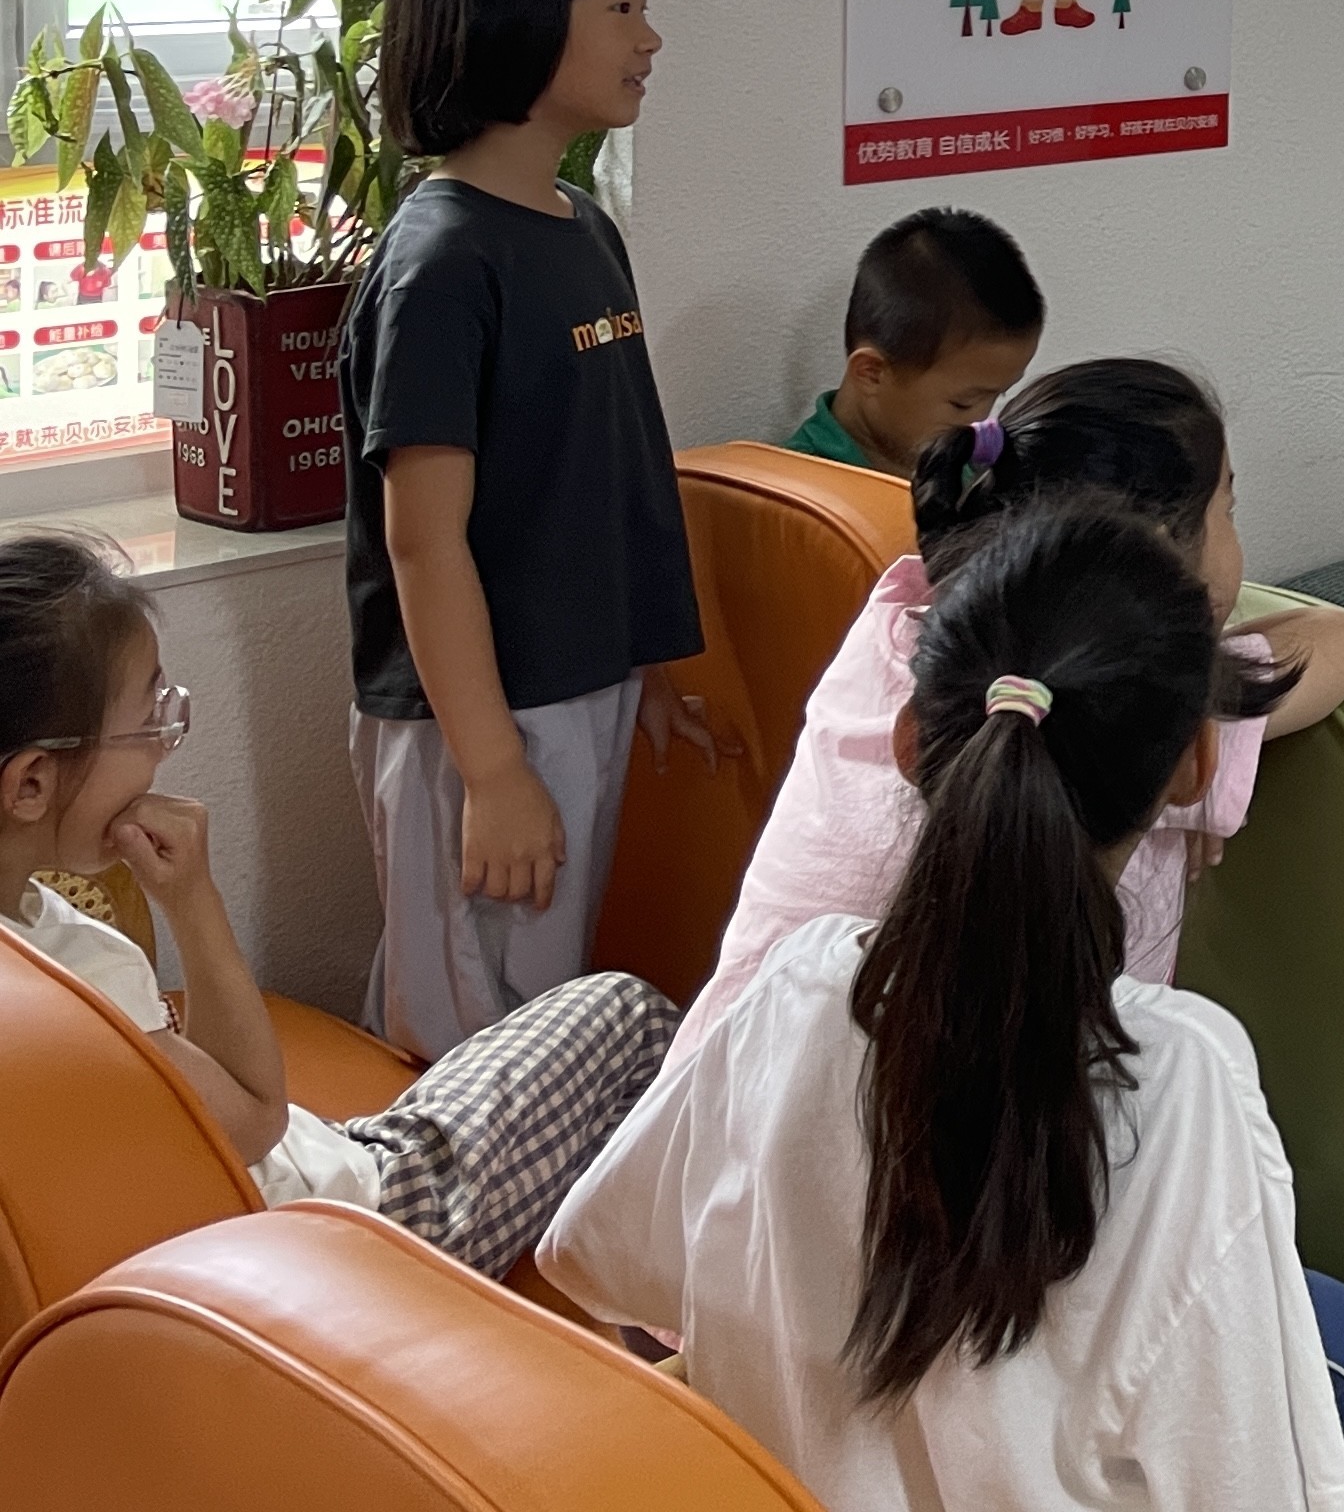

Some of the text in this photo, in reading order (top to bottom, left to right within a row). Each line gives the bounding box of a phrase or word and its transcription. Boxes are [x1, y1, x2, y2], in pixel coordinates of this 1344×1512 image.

[857, 137, 933, 164] 优势教育
[939, 130, 1010, 156] 自信成长
[212, 306, 239, 516] LOVE
[177, 441, 206, 468] 1968
[289, 446, 341, 472] 1968
